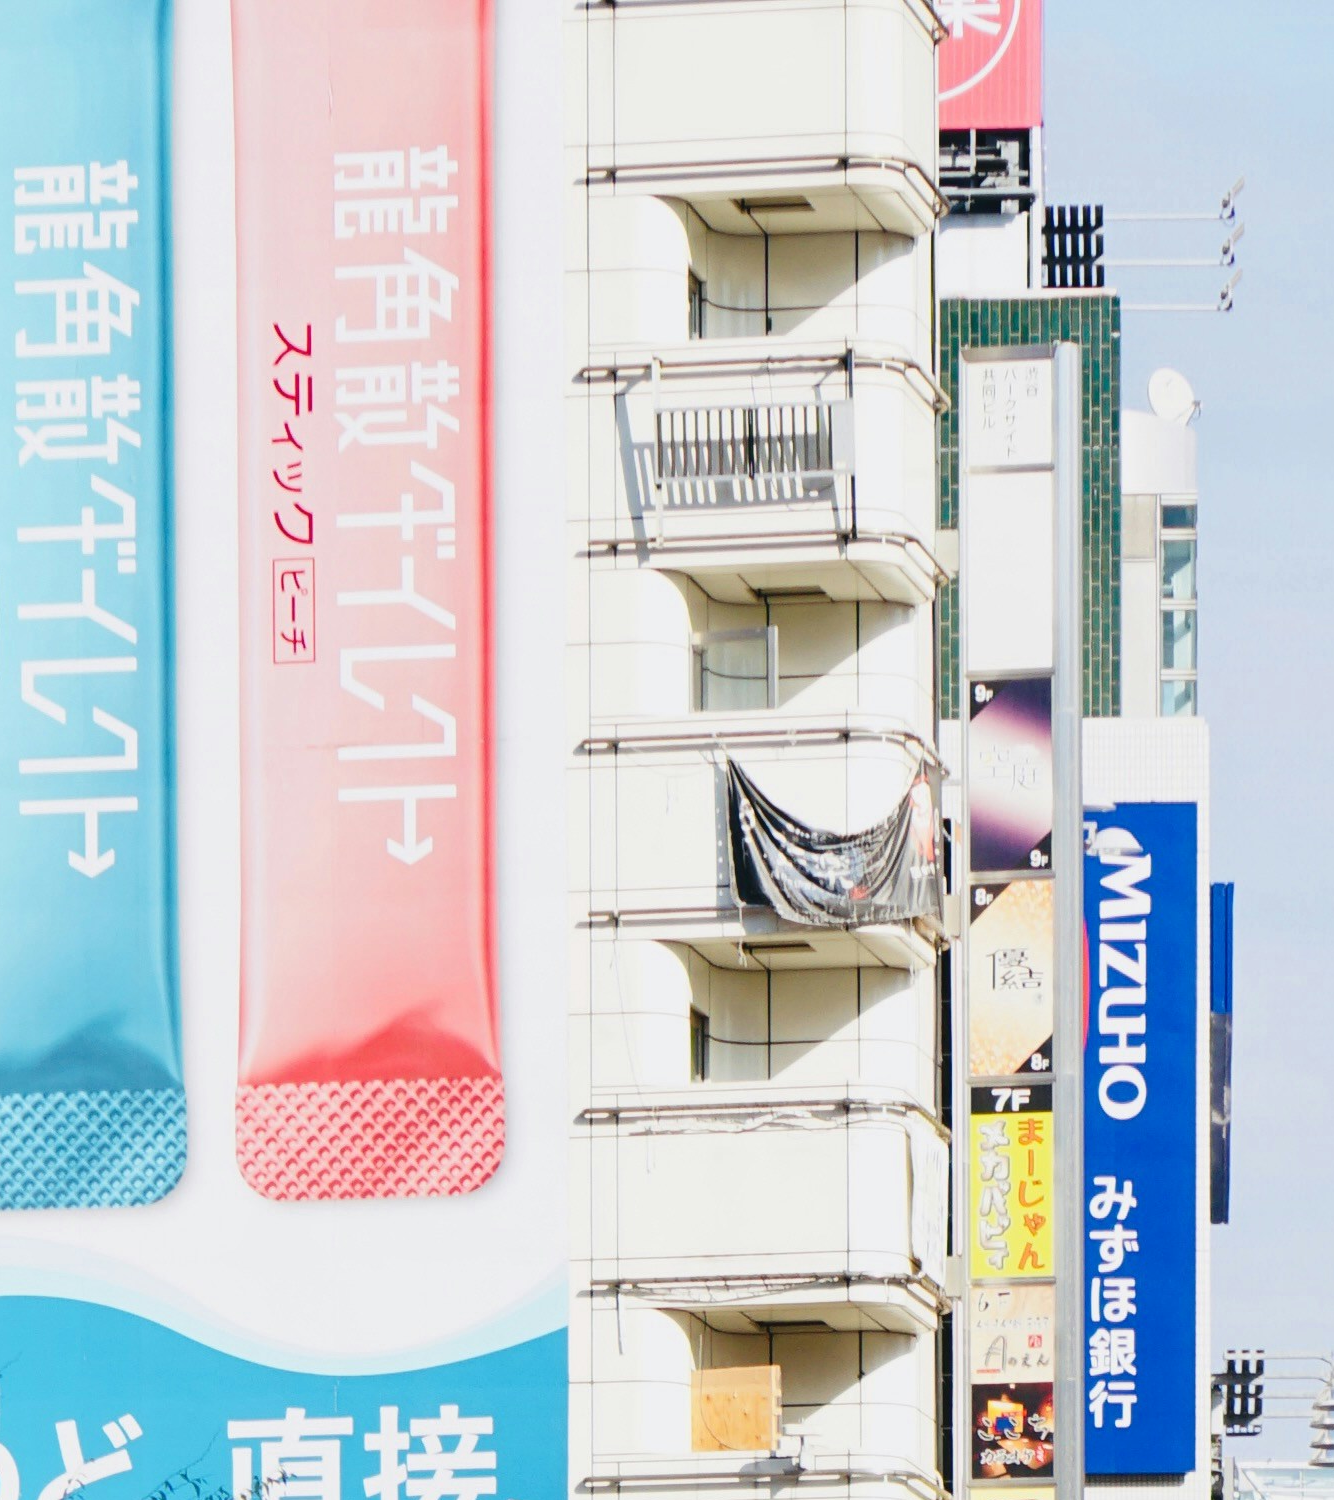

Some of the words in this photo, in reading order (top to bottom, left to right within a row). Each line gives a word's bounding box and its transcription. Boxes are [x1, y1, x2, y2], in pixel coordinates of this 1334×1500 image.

[12, 159, 143, 879] 龍角散ダイレクト
[271, 323, 315, 546] スティック
[332, 145, 461, 867] 龍角散ダイレクト
[279, 566, 305, 656] ピーチ
[974, 887, 994, 906] 8F
[1098, 852, 1152, 1121] MIZUHO
[991, 1087, 1031, 1112] 7F
[1030, 1052, 1050, 1072] 8F
[1017, 1117, 1047, 1271] まーじゃん
[1088, 1175, 1140, 1429] みずほ銀行
